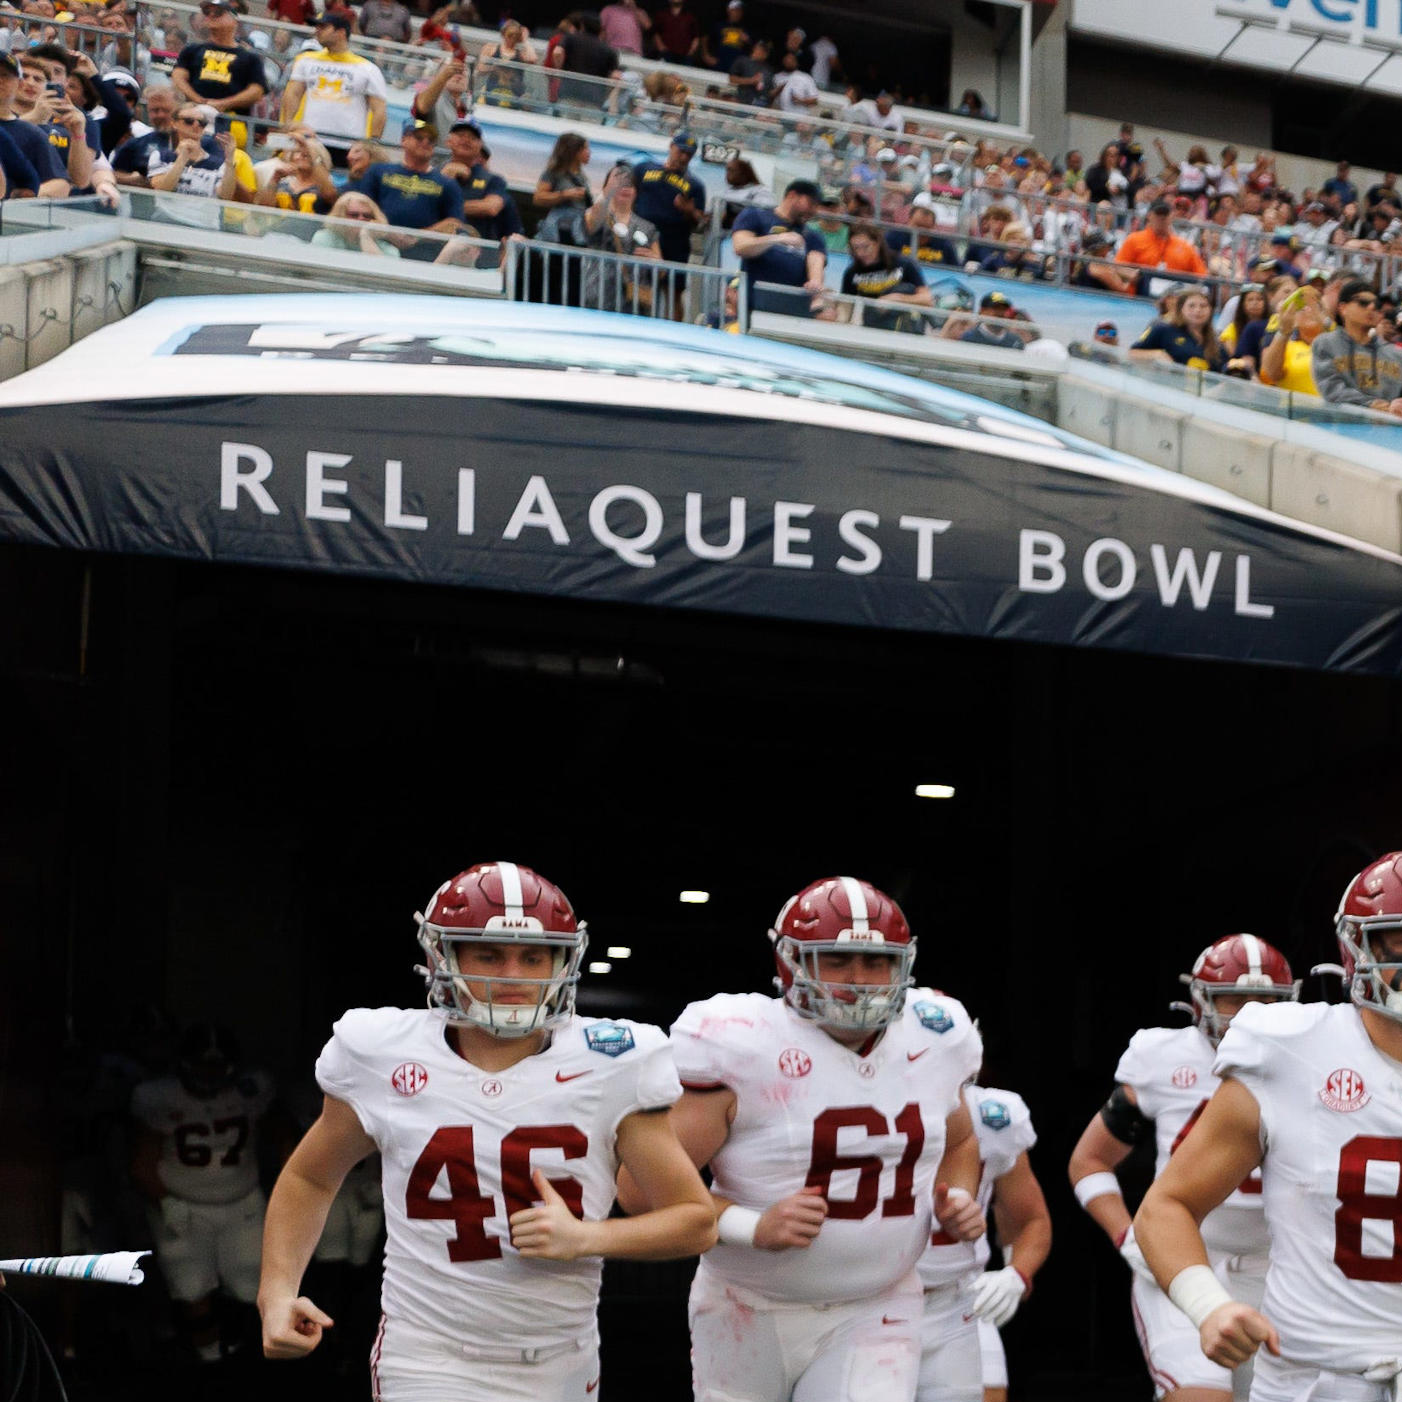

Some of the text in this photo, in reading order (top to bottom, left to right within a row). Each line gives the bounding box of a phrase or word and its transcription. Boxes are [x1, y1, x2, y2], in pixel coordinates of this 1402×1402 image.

[220, 441, 1276, 620] RELIAQUEST BOWL
[392, 1062, 428, 1097] SEC
[1326, 1068, 1364, 1102] SEC
[175, 1116, 248, 1167] 67
[805, 1102, 925, 1220] 61
[406, 1124, 589, 1263] 46
